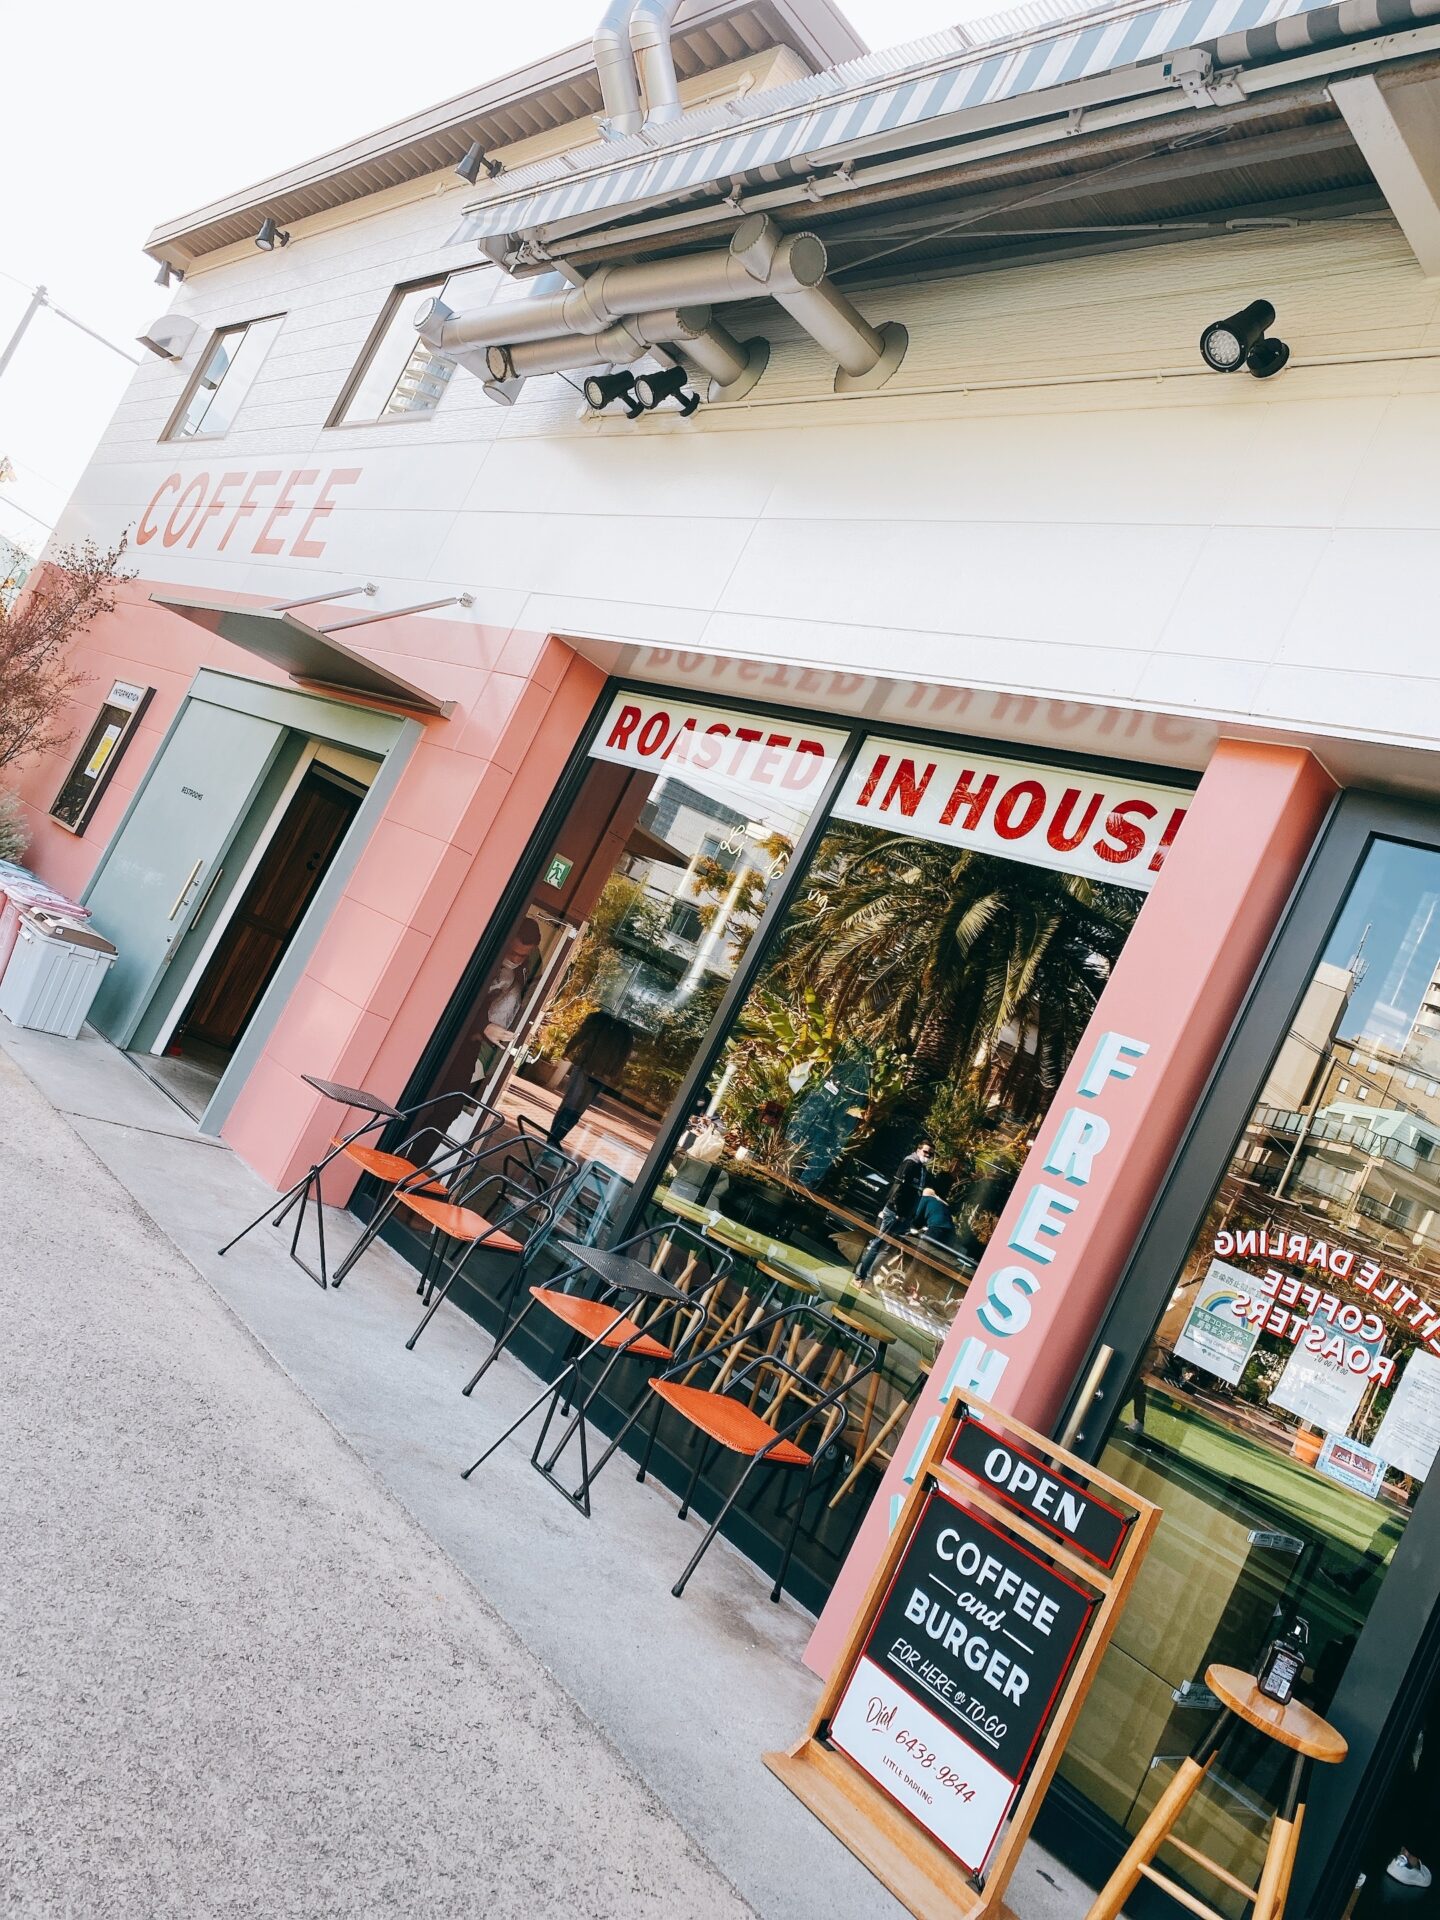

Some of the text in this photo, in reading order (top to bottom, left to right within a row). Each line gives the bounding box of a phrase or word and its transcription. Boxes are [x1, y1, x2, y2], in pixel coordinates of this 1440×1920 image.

[135, 467, 363, 558] COFFEE
[604, 705, 826, 790] ROASTED
[856, 754, 937, 817] IN
[984, 1448, 1087, 1533] OPEN
[936, 1528, 1060, 1637] COFFEE
[957, 1591, 1006, 1631] and
[891, 1637, 921, 1668] FOR
[918, 1659, 957, 1697] HERE
[965, 1697, 1008, 1739] TO-GO
[904, 1587, 1030, 1707] BURGER
[866, 1697, 898, 1730] Dial
[882, 1755, 933, 1805] LITTLE DARLING
[895, 1730, 976, 1803] 6438-9844
